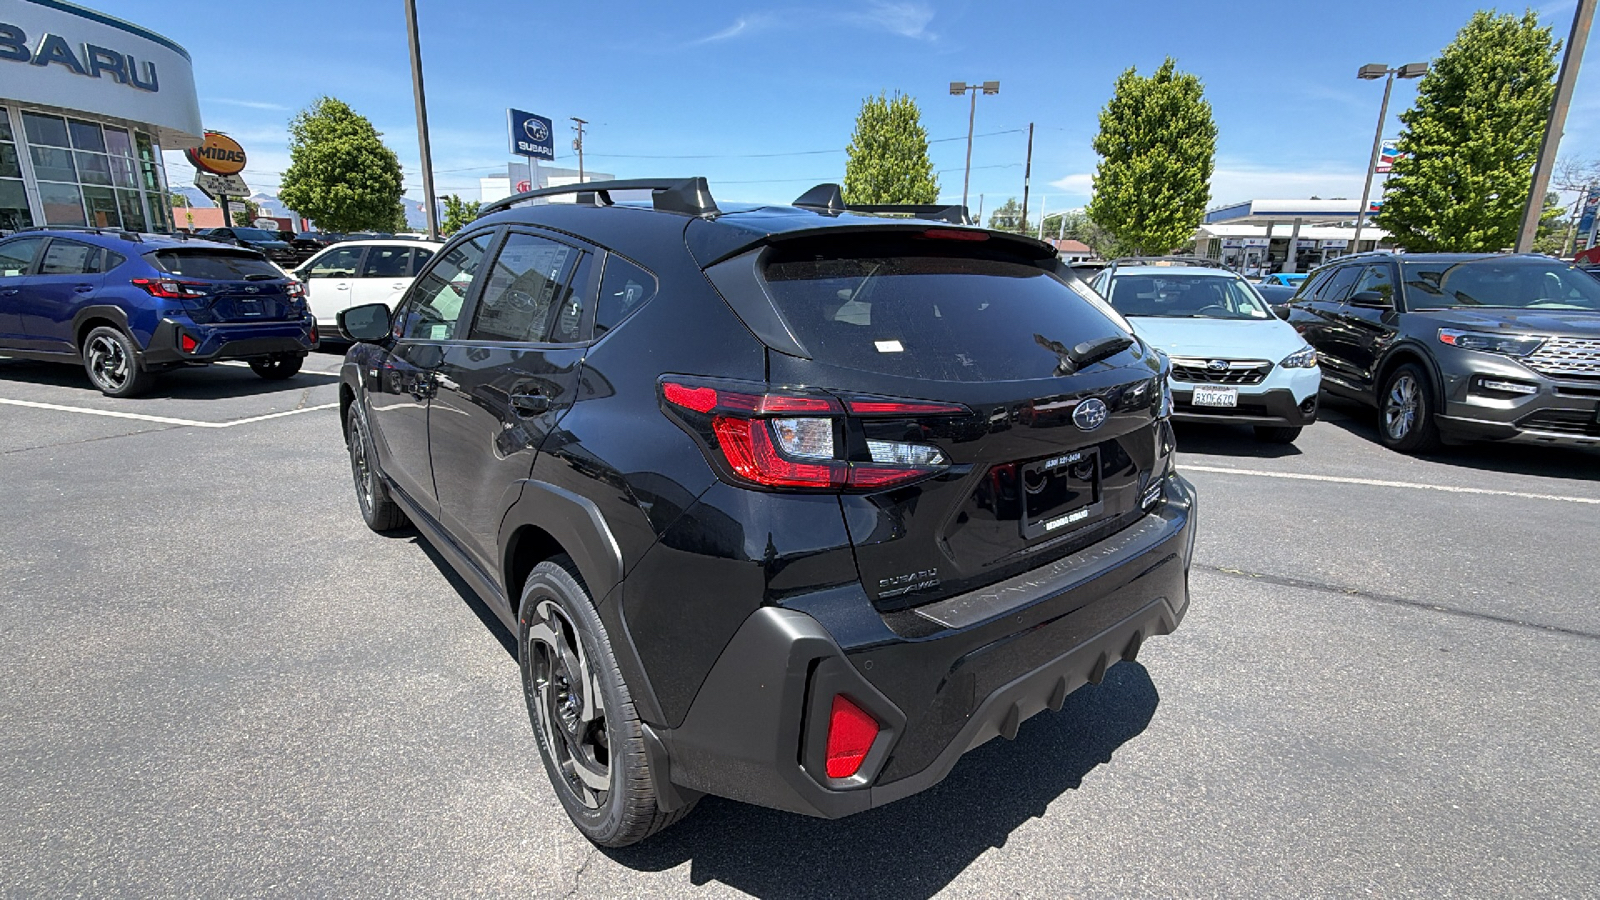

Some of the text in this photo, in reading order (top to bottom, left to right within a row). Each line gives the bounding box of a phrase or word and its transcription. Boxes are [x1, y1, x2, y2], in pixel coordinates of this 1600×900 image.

[198, 147, 244, 163] MIDAS
[518, 141, 552, 156] SUBARU
[879, 567, 938, 588] SUBARU
